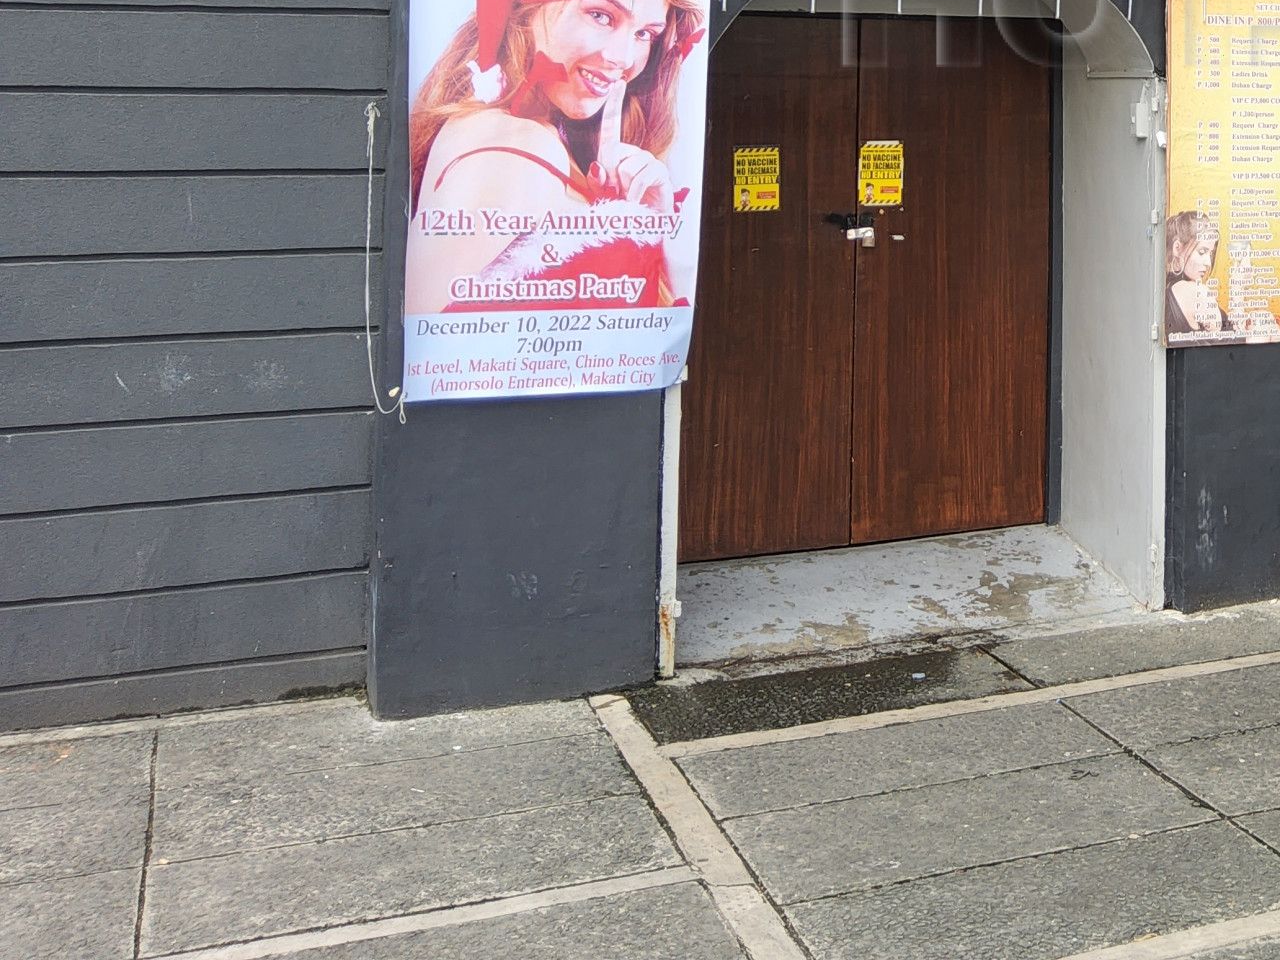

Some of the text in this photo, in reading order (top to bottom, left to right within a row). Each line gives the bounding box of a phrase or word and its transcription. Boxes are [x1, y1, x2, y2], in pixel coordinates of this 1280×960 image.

[1207, 15, 1232, 25] DINE
[747, 158, 778, 167] VACCINE
[872, 153, 901, 161] VACCINE
[748, 176, 777, 184] ENTRY
[419, 210, 681, 236] 12th Year Anniversary
[541, 244, 560, 263] &
[451, 275, 644, 302] Christmas Party
[417, 313, 673, 336] December 10, 2022 Saturday
[516, 337, 583, 356] 7:00pm
[425, 359, 462, 375] Level,
[468, 357, 516, 373] Makati
[520, 356, 570, 374] Square,
[575, 354, 614, 369] Chino
[618, 353, 655, 367] Roces
[658, 352, 680, 365] Ave.
[431, 369, 655, 395] (Amorsolo Entrance), Makati City
